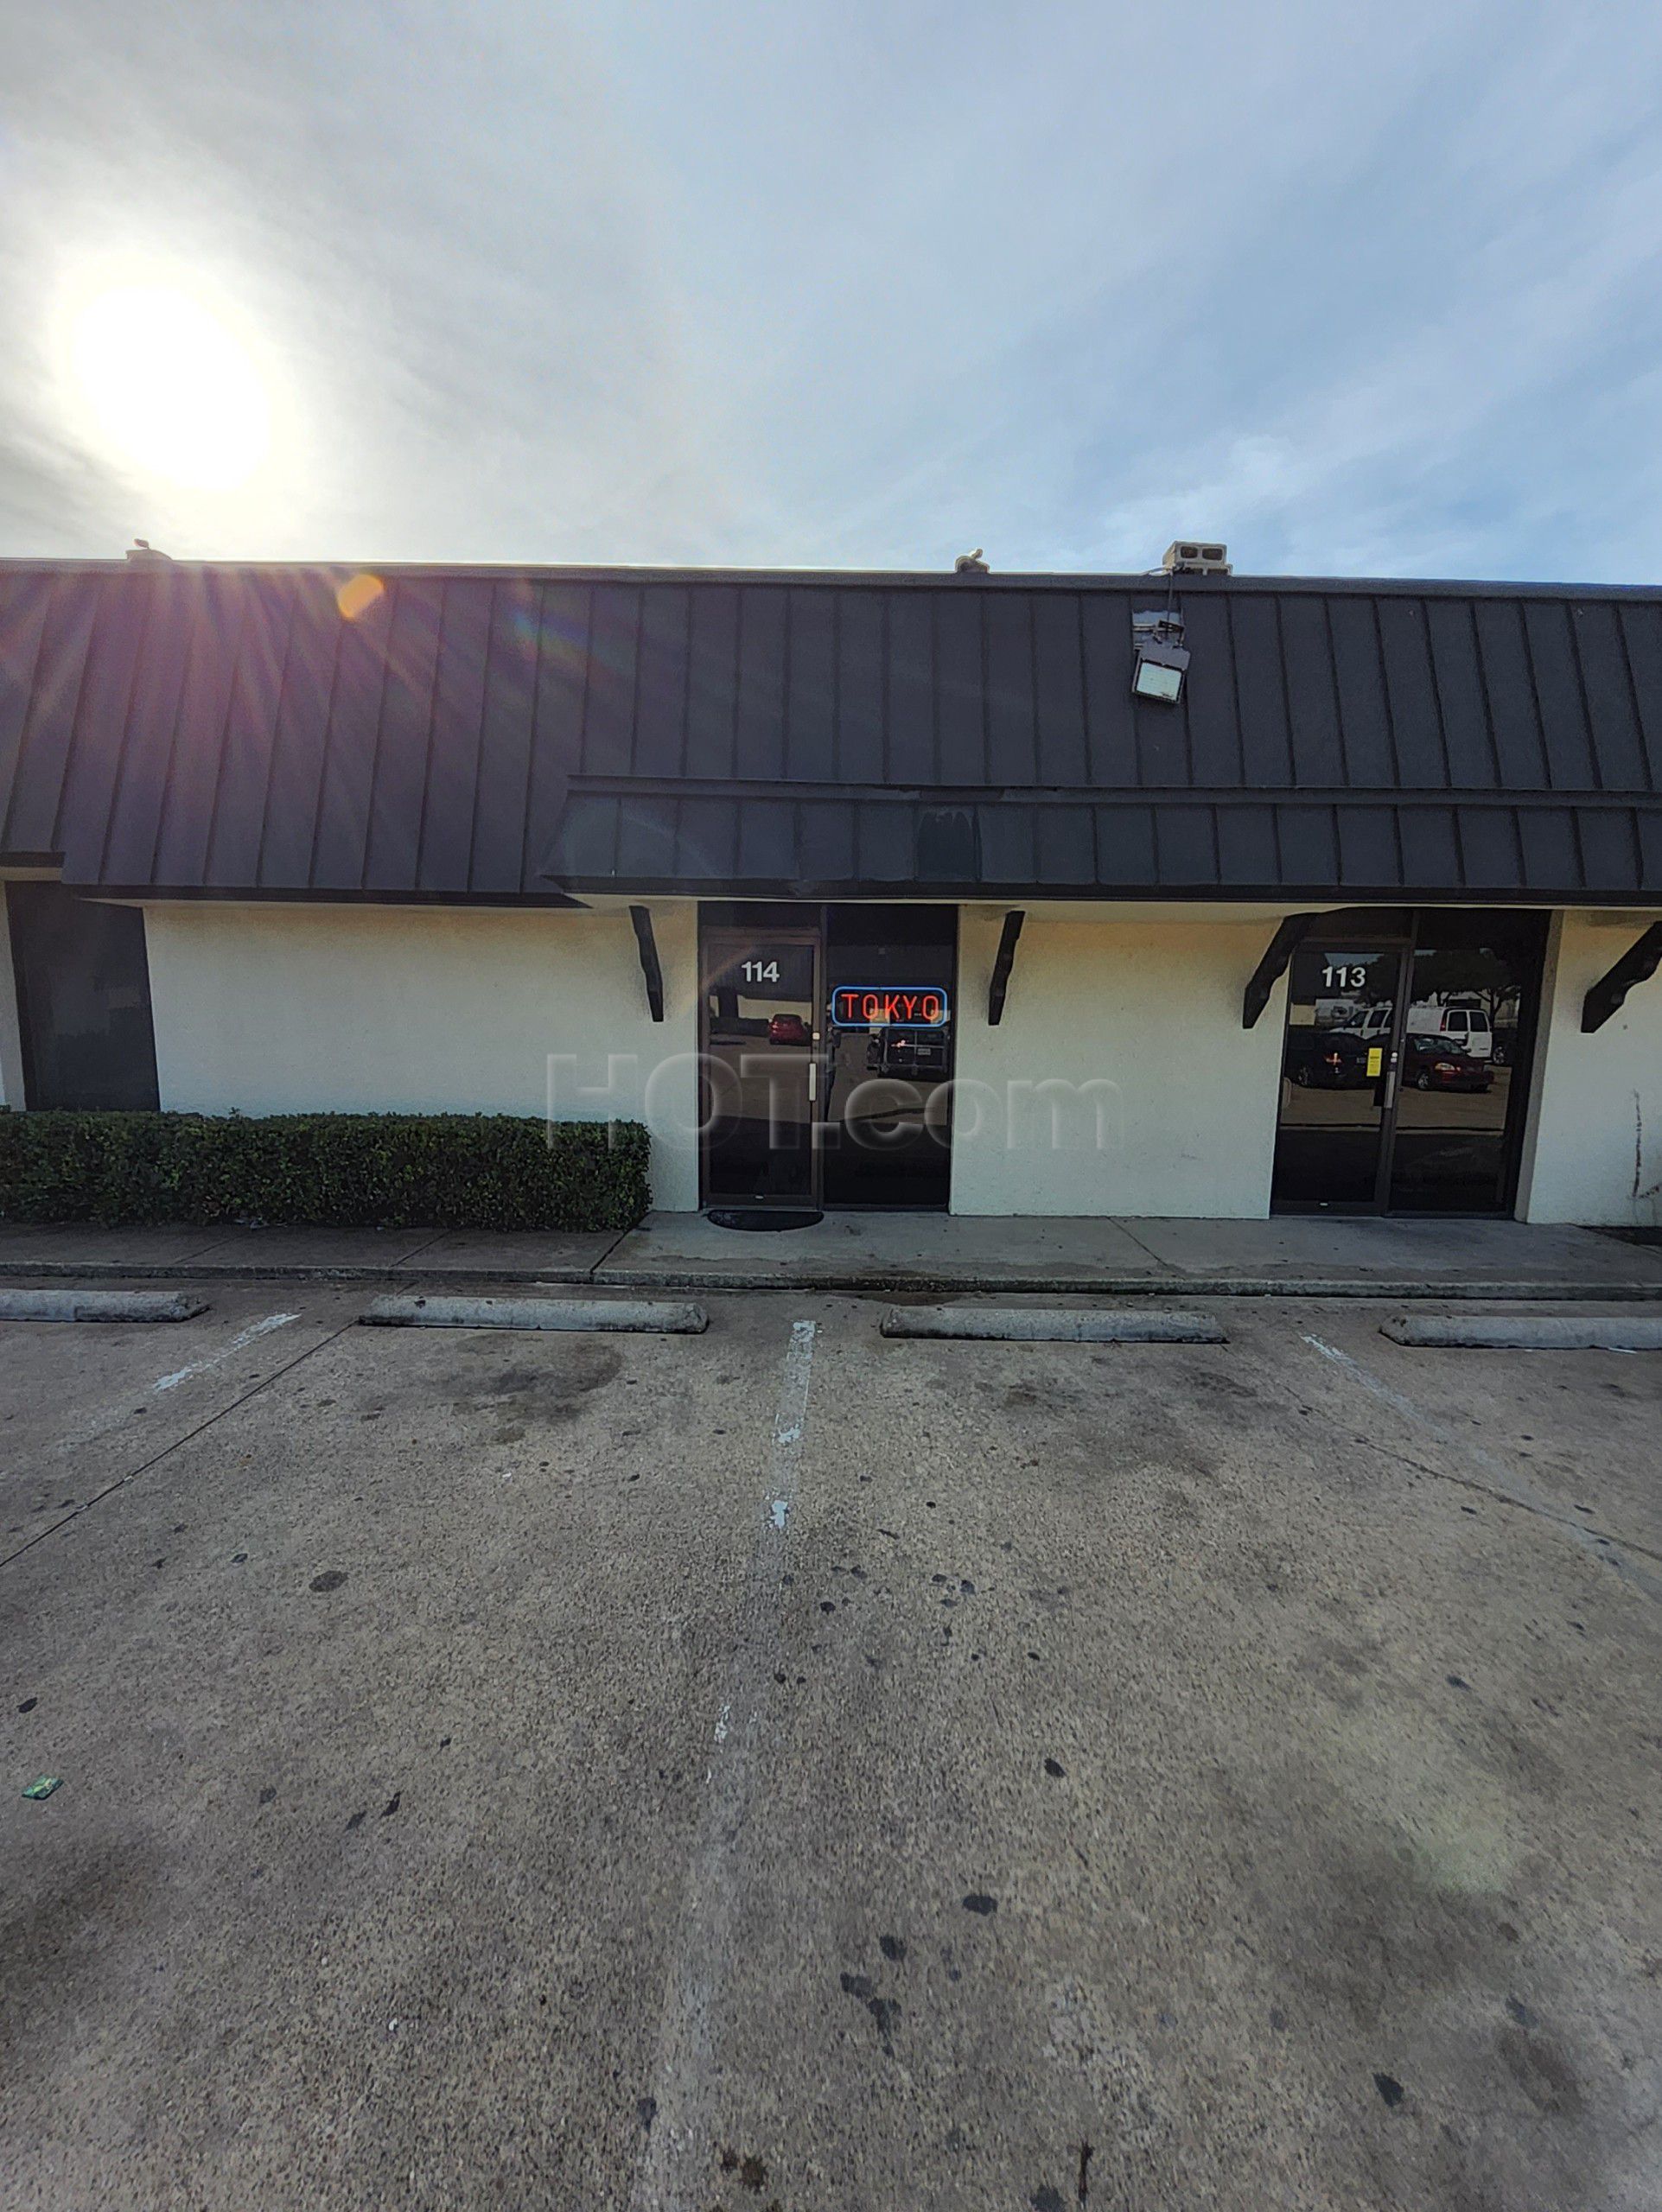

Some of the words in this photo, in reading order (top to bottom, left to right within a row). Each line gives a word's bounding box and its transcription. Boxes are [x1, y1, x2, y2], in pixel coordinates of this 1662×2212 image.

[741, 961, 780, 982] 114
[1321, 966, 1366, 988] 113
[840, 993, 940, 1020] TOKYO
